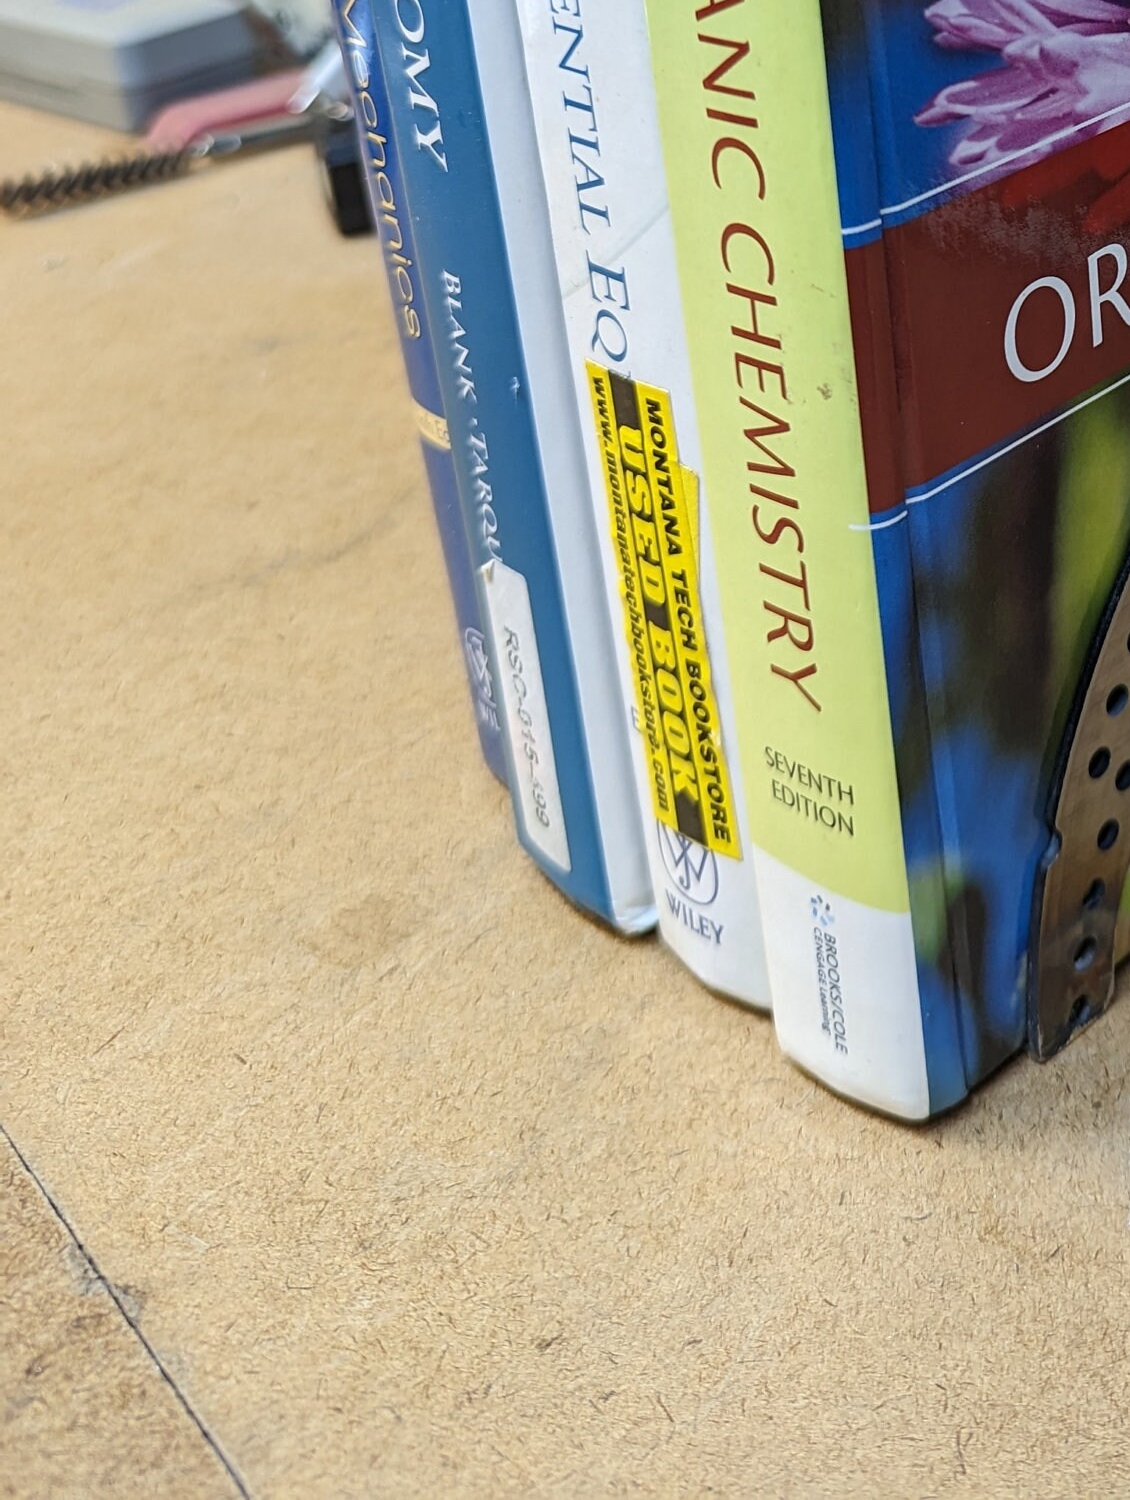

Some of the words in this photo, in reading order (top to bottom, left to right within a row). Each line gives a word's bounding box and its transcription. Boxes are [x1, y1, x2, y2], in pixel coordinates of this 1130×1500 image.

[586, 249, 632, 372] EQ
[442, 269, 478, 405] BLANK
[469, 431, 503, 565] TARQU
[720, 221, 823, 712] CHEMISTRY
[592, 376, 671, 813] www.montanatechbookstore.com
[617, 422, 667, 607] USED
[648, 618, 699, 802] BOOK
[645, 397, 683, 556] MONTANA
[671, 567, 698, 652] TECH
[685, 657, 732, 844] BOOKSTORE
[764, 745, 855, 806] SEVENTH
[770, 777, 855, 837] EDITION
[665, 887, 724, 945] WILEY
[812, 926, 829, 988] CENGAGE
[823, 931, 849, 1055] BROOKS/COLE
